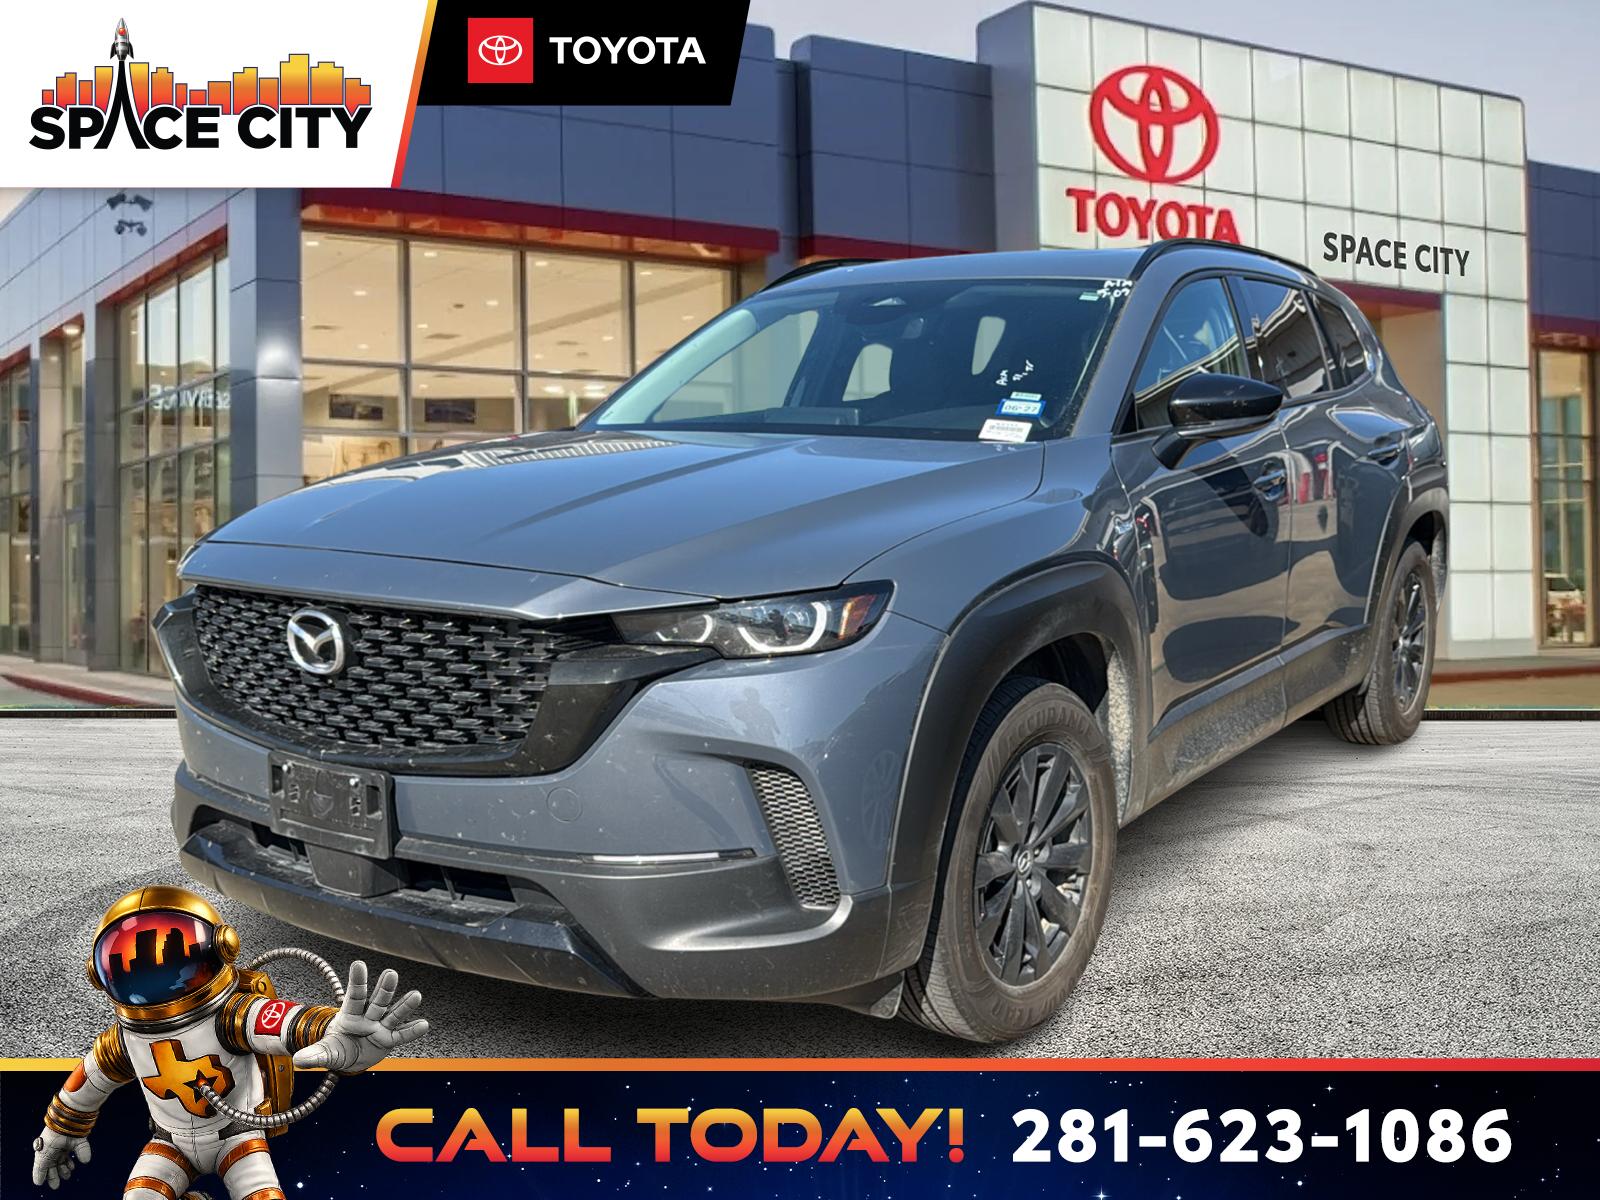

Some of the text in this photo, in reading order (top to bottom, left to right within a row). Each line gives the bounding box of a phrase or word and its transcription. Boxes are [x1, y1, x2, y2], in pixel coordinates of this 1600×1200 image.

[1065, 188, 1241, 245] TOYOTA
[1323, 232, 1470, 276] SPACE CITY
